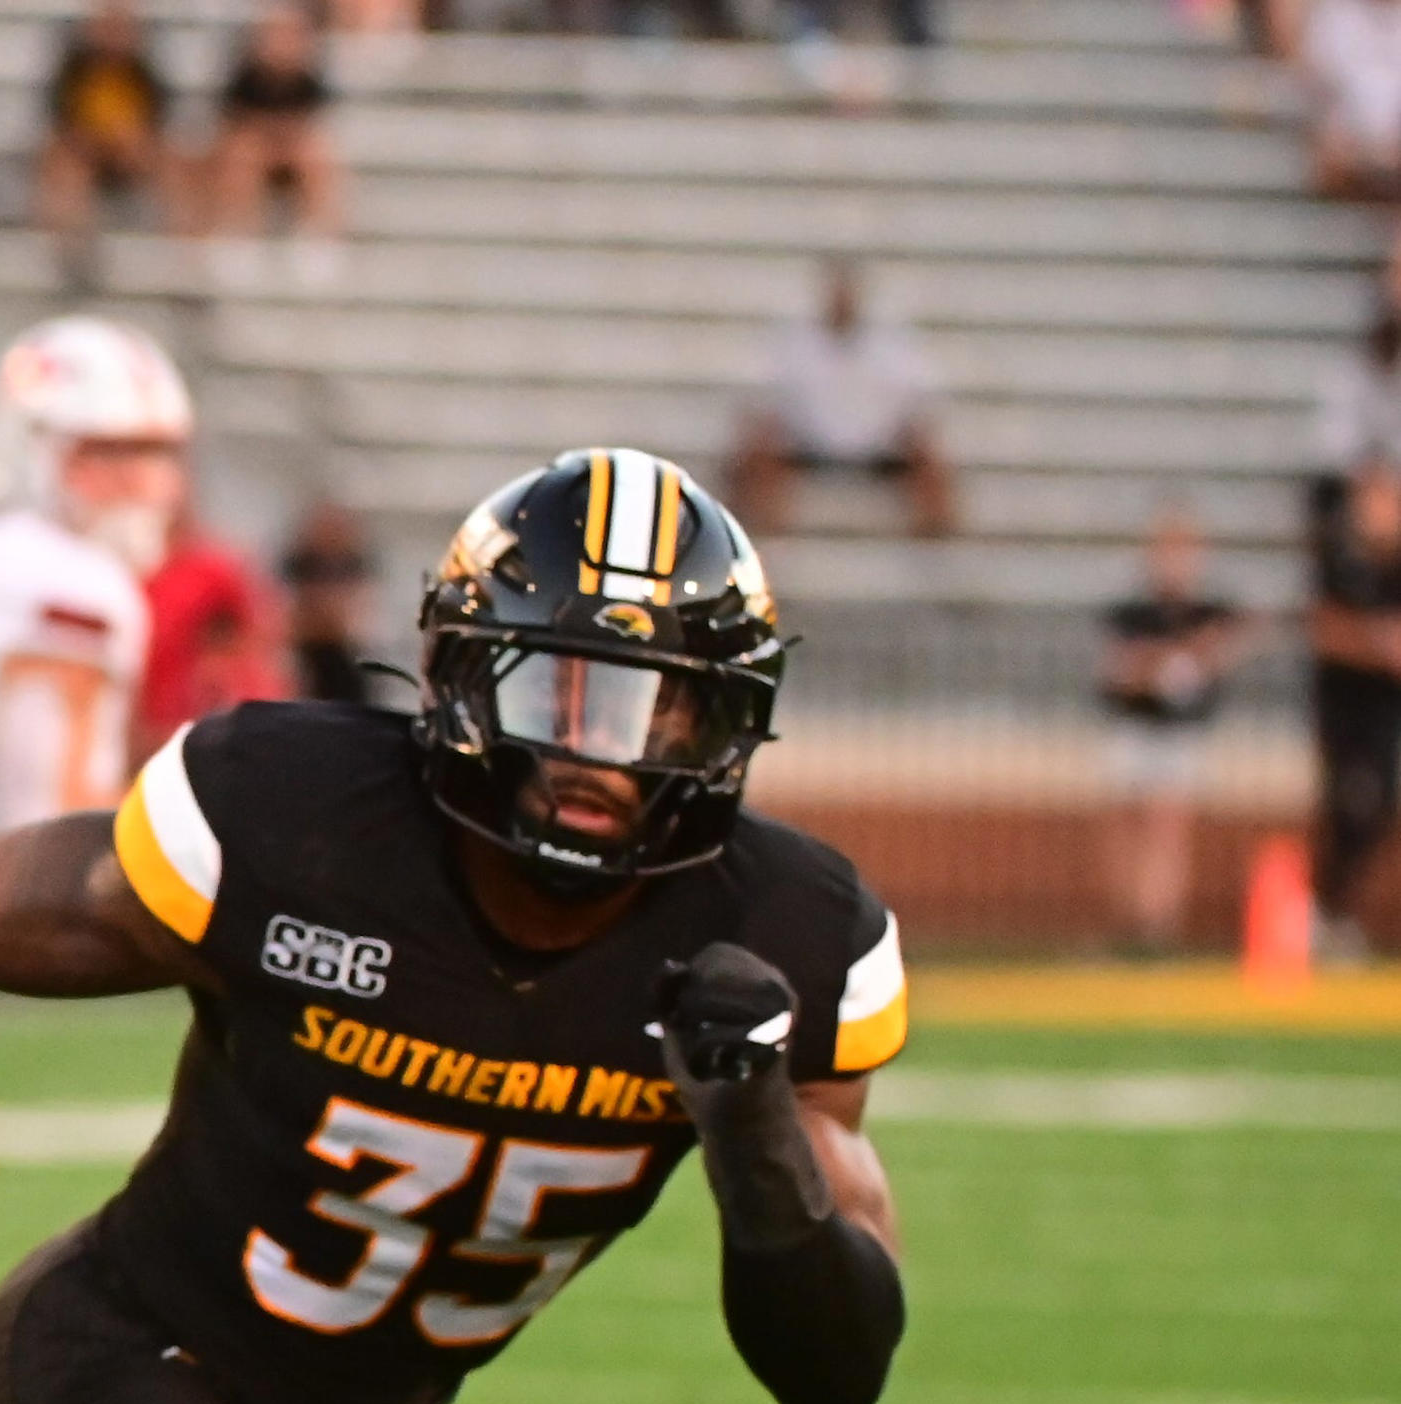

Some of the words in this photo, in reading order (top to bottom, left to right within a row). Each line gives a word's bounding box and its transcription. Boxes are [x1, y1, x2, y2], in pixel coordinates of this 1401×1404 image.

[261, 914, 393, 998] SBC
[293, 1004, 578, 1114] SOUTHERN
[578, 1065, 682, 1120] MIS
[243, 1095, 653, 1347] 35
